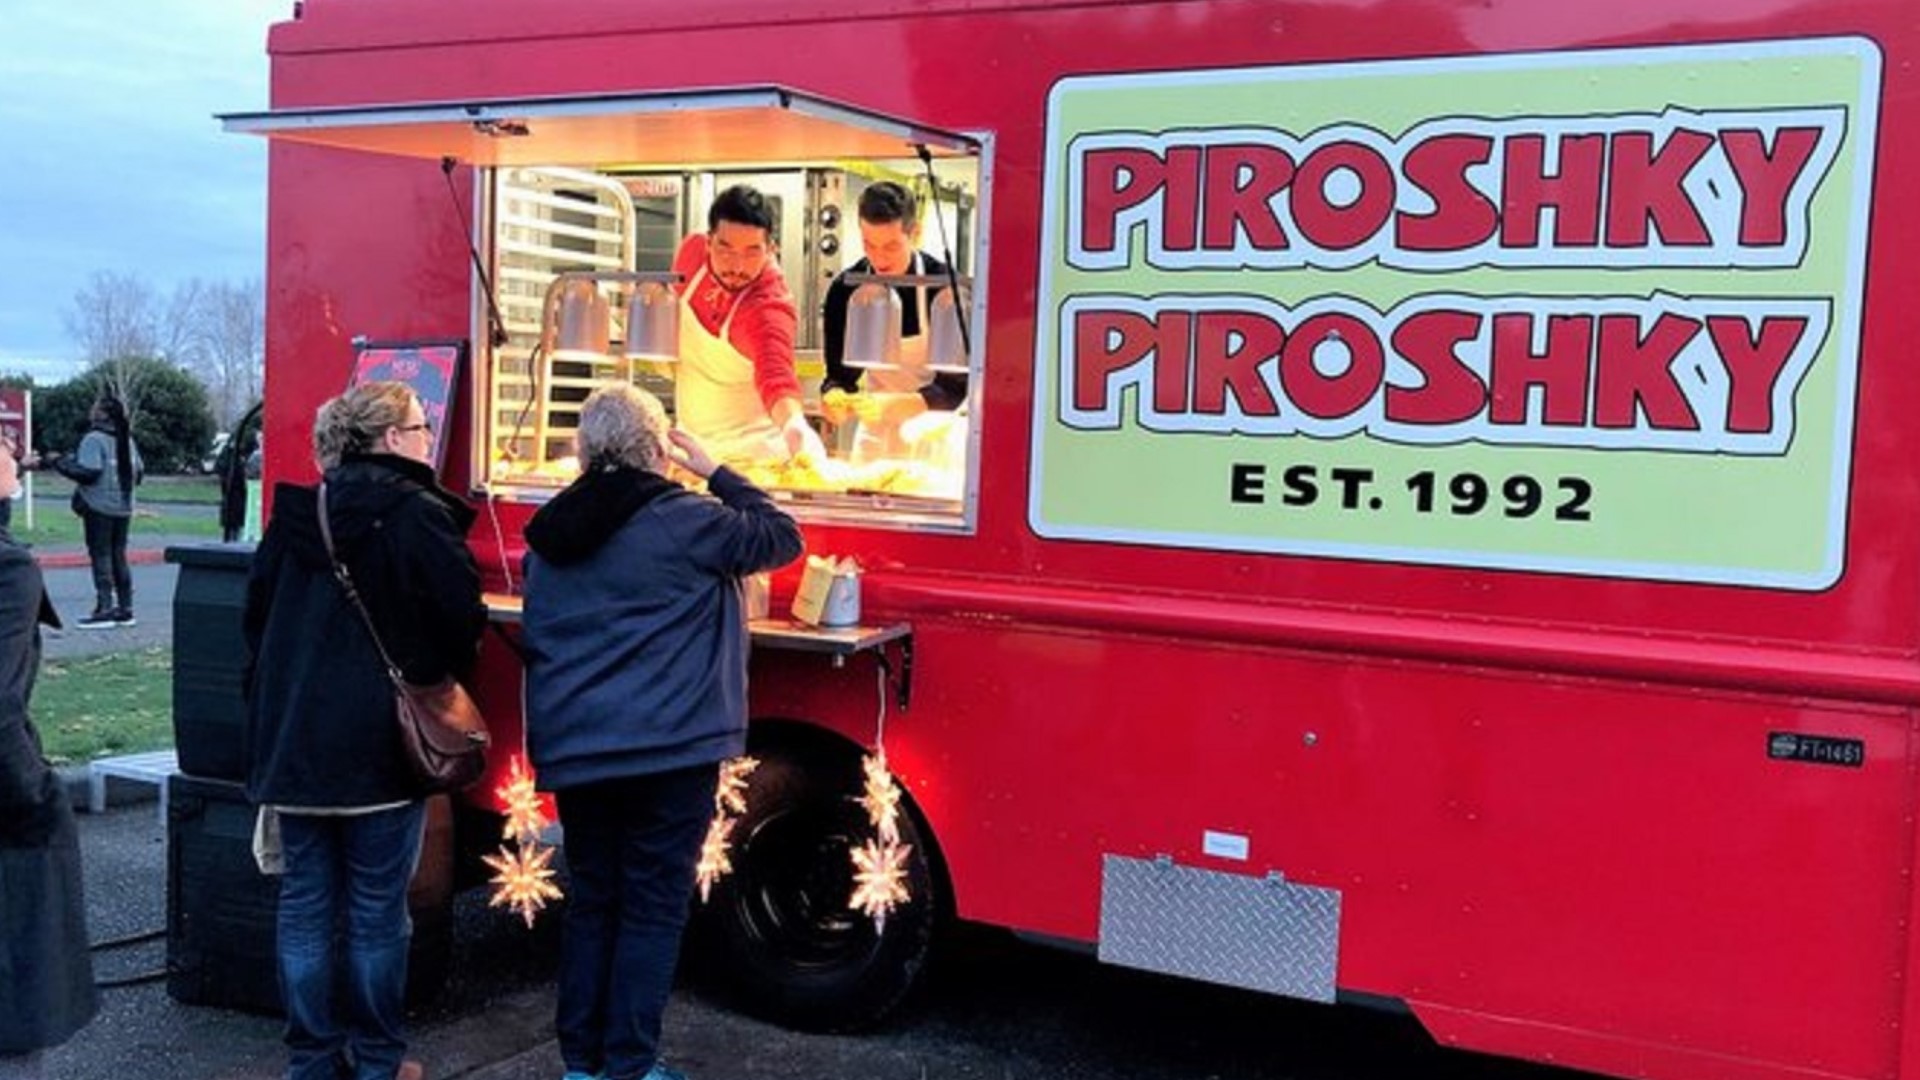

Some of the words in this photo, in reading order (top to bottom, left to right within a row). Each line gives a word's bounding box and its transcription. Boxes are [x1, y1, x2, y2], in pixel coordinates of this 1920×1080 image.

[1080, 127, 1824, 252] PIROSHKY
[1072, 310, 1808, 433] PIROSHKY
[1230, 464, 1382, 511] EST.
[1405, 472, 1593, 521] 1992
